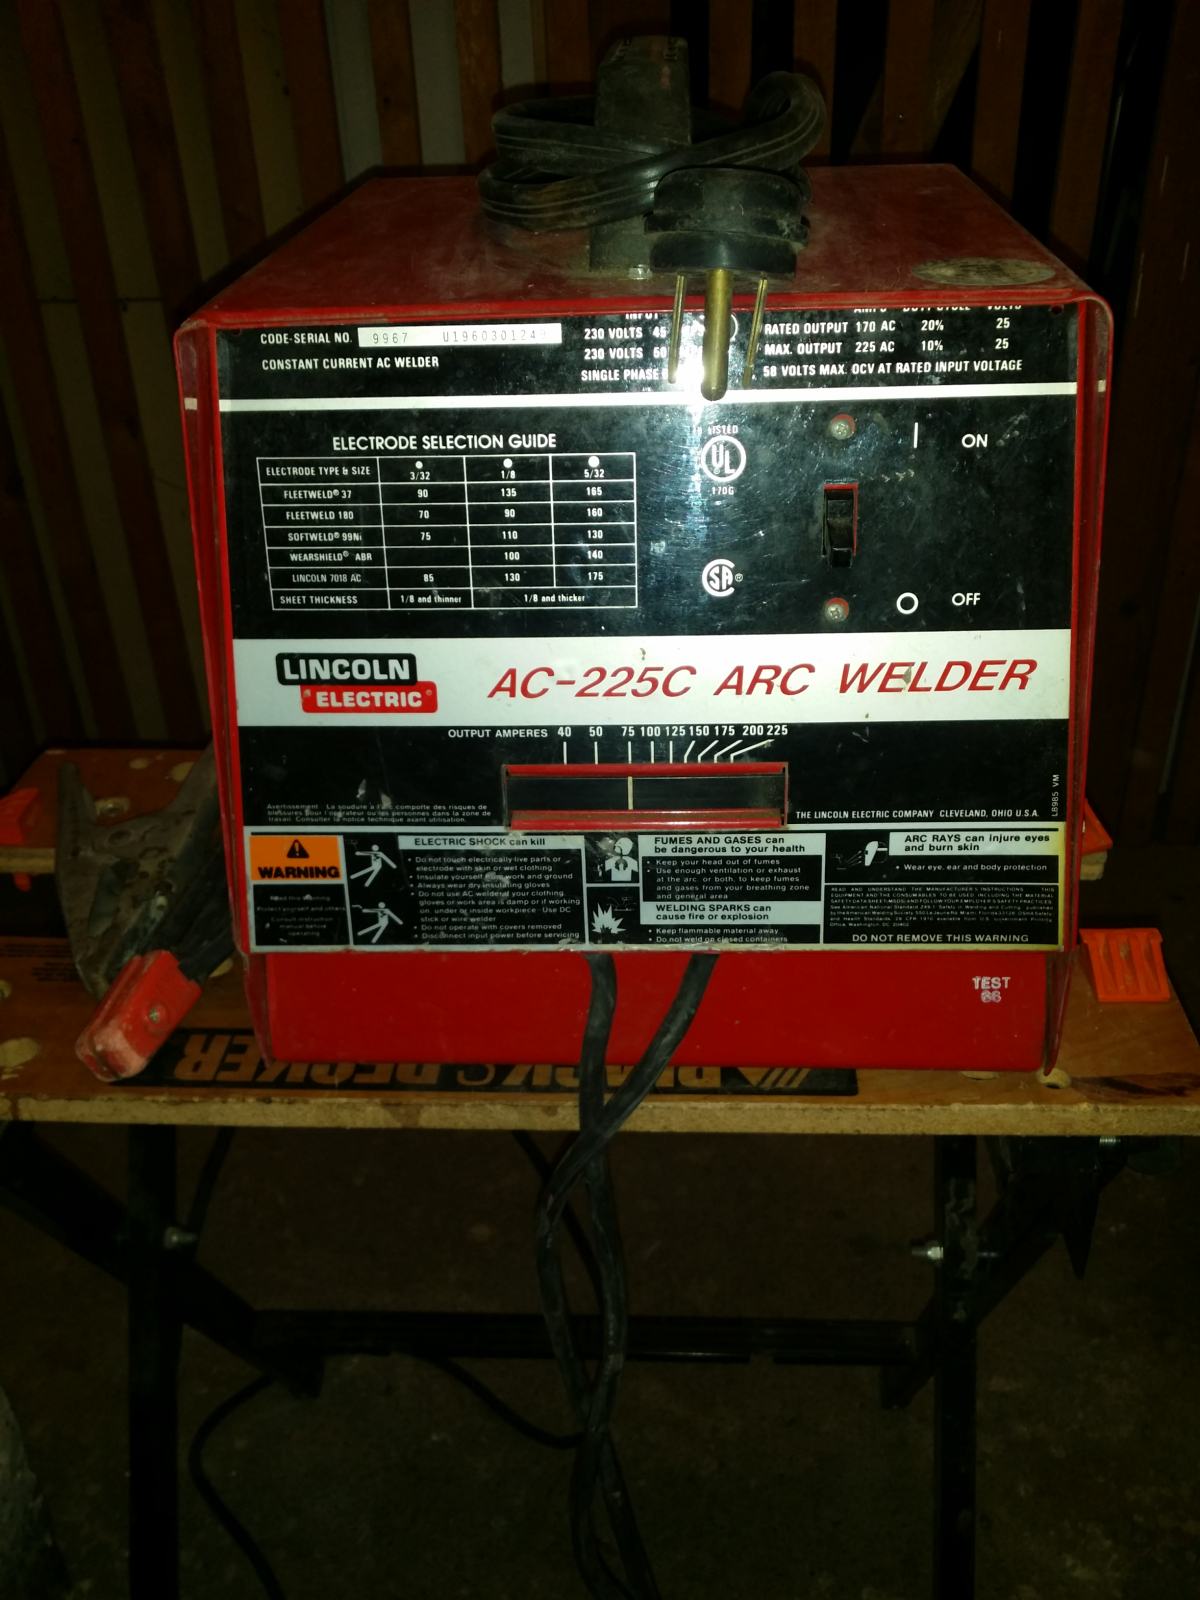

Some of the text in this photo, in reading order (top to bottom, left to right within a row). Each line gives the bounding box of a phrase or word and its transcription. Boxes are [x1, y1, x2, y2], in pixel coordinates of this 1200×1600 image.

[764, 317, 1011, 335] RATED OUTPUT 170 AC 20% 25
[260, 332, 331, 344] CODE-SERIAL
[334, 331, 352, 343] NO.
[372, 331, 409, 345] 9967
[584, 328, 604, 340] 230
[608, 327, 643, 339] VOLTS
[653, 326, 667, 339] 45
[764, 338, 1009, 356] MAX. OUTPUT 225 AC 10% 25
[584, 348, 605, 360] 230
[609, 347, 644, 359] VOLTS
[262, 356, 439, 370] CONSTANT CURRENT AC WELDER
[781, 364, 816, 376] VOLTS
[819, 363, 848, 376] MAX.
[851, 362, 875, 375] OCV
[877, 362, 892, 374] AT
[895, 361, 932, 374] RATED
[935, 360, 969, 373] INPUT
[973, 359, 1023, 372] VOLTAGE
[581, 369, 620, 382] SINGLE
[624, 368, 659, 381] PHASE
[332, 433, 557, 451] ELECTRODE SELECTION GUIDE
[961, 433, 988, 448] ON
[266, 466, 316, 476] ELECTRODE
[318, 466, 340, 476] TYPE
[351, 466, 371, 476] SIZE
[410, 471, 431, 481] 3/32
[501, 470, 516, 480] 1/8
[583, 469, 605, 479] 5/32
[341, 490, 352, 499] 37
[417, 489, 429, 498] 90
[501, 487, 517, 497] 135
[586, 486, 603, 496] 165
[286, 511, 354, 520] FLEETWELD 180
[419, 510, 430, 519] 70
[504, 509, 516, 518] 90
[586, 508, 603, 517] 160
[420, 532, 431, 541] 75
[502, 530, 518, 540] 110
[587, 530, 604, 539] 130
[355, 553, 373, 561] ABR
[504, 552, 520, 561] 100
[587, 550, 604, 560] 140
[292, 573, 362, 583] LINCOLN 7018 AC
[423, 573, 435, 583] 85
[504, 572, 521, 582] 130
[587, 572, 604, 581] 175
[280, 595, 358, 605] SHEET THICKNESS
[400, 594, 462, 604] 1/8 and thinner
[524, 593, 586, 603] 1/8 and thicker
[951, 592, 981, 606] OFF
[282, 658, 411, 681] LINCOLN
[487, 658, 1038, 699] AC-225C ARC WELDER
[316, 691, 423, 709] ELECTRIC
[448, 724, 789, 739] OUTPUT AMPERES 40 50 75 100 125 150 175 200 225
[796, 811, 812, 820] THE
[814, 810, 850, 819] LINCOLN
[851, 810, 890, 819] ELECTRIC
[892, 809, 935, 819] COMPANY
[991, 809, 1013, 818] OHIO
[414, 837, 546, 846] ELECTRIC SHOCK can kill
[654, 836, 785, 845] FUMES AND GASES can
[904, 833, 1051, 844] ARC RAYS can injure eyes
[654, 844, 806, 855] be dangerous to your health
[904, 843, 980, 852] and burn skin
[656, 859, 678, 867] Keep
[680, 859, 699, 867] your
[702, 858, 723, 866] head
[742, 858, 752, 866] of
[754, 858, 781, 866] fumes
[903, 863, 926, 871] Wear
[962, 863, 979, 871] and
[980, 863, 1002, 872] body
[1003, 863, 1048, 872] protection
[258, 866, 341, 879] WARNING
[655, 904, 706, 913] WELDING
[708, 904, 751, 913] SPARKS
[655, 912, 769, 922] cause fire or explosion
[852, 933, 1029, 943] DO NOT REMOVE THIS WARNING
[972, 976, 1011, 990] TEST
